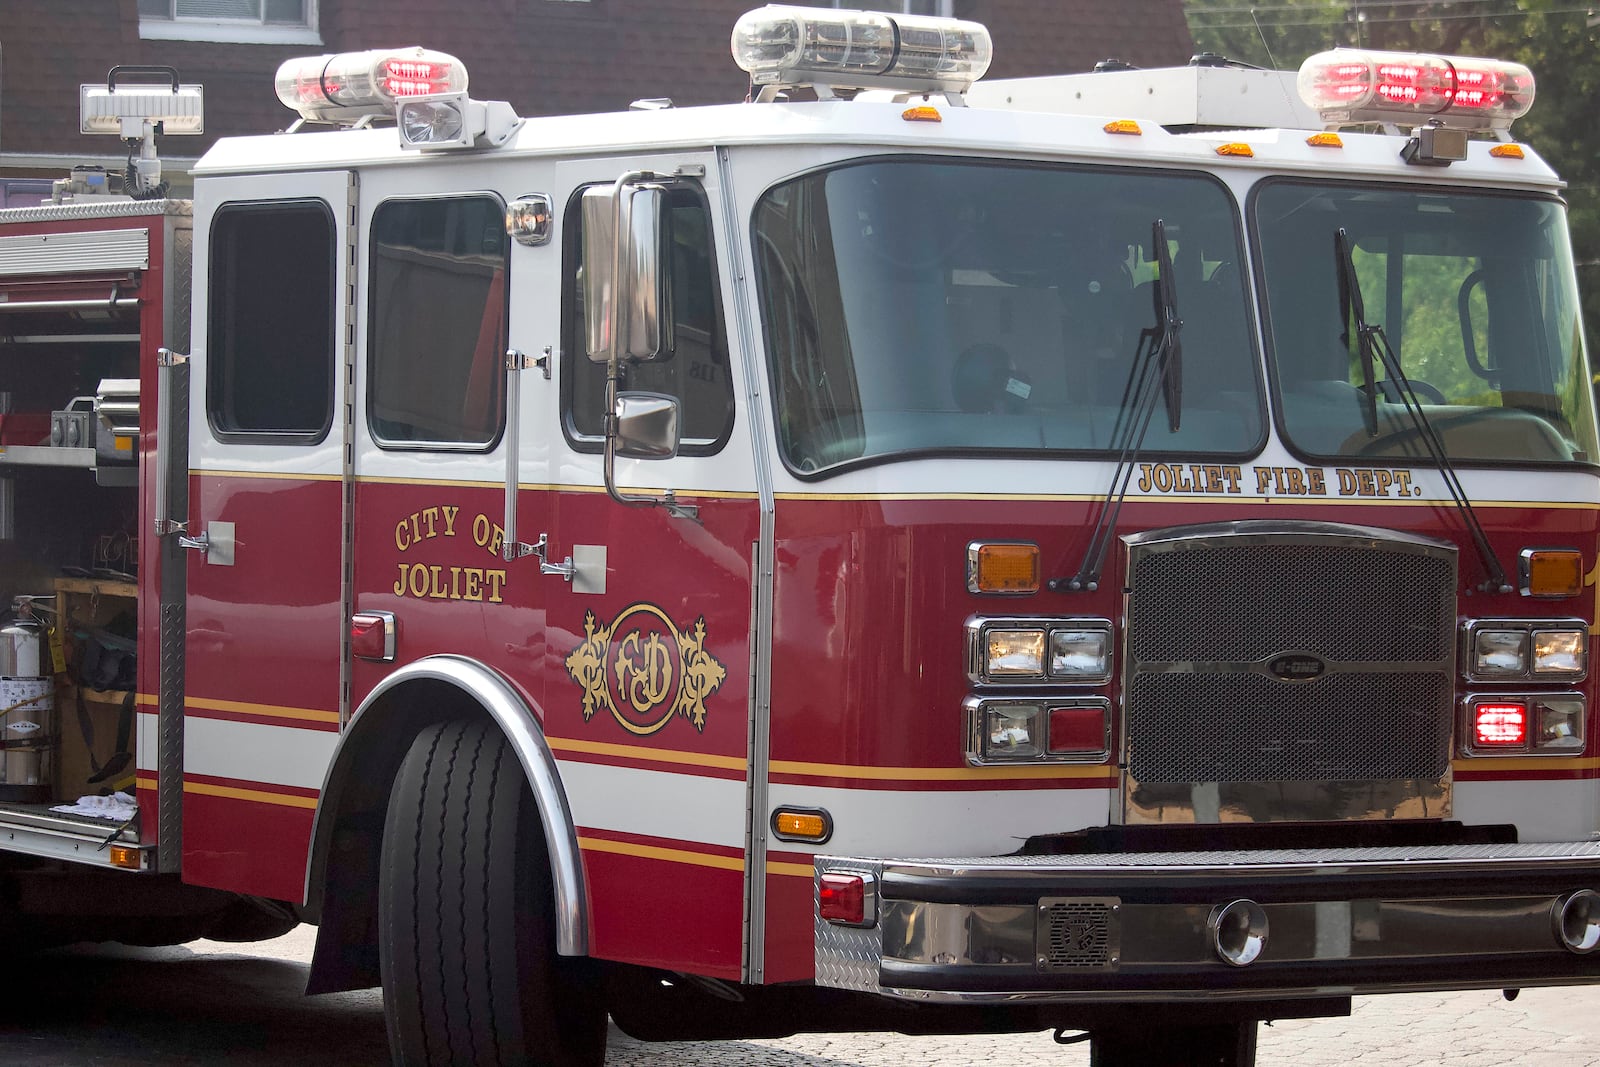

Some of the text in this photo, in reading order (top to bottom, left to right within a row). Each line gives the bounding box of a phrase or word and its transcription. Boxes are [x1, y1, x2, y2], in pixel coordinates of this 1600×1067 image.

[1138, 463, 1421, 497] JOLIET FIRE DEPT.
[395, 505, 505, 557] CITY OF
[394, 563, 507, 603] JOLIET
